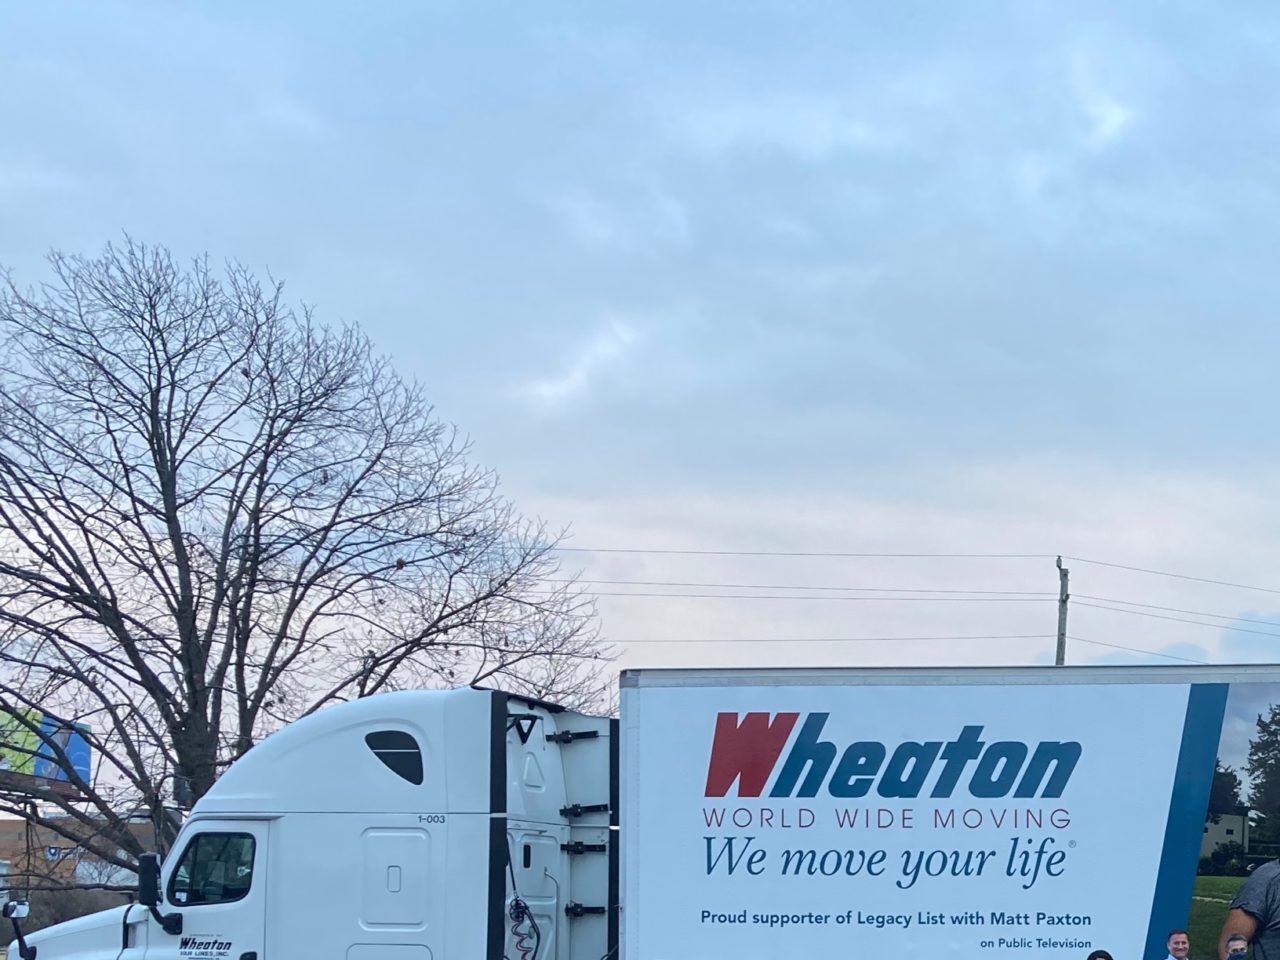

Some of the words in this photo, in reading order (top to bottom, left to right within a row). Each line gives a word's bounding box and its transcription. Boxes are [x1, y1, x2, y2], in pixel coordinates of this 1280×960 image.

[704, 712, 1082, 798] Wheaton
[417, 815, 446, 824] 1-003
[702, 807, 815, 829] WORLD
[834, 808, 913, 829] WIDE
[934, 808, 1071, 829] MOVING
[703, 836, 767, 876] We
[781, 849, 887, 876] move
[896, 849, 996, 889] your
[701, 910, 747, 924] Proud
[752, 912, 831, 928] supporter
[835, 911, 853, 925] of
[857, 911, 912, 928] Legacy
[918, 911, 946, 925] List
[950, 911, 985, 925] with
[990, 912, 1030, 925] Matt
[1036, 912, 1092, 926] Paxton
[179, 937, 232, 950] Wheaton
[980, 941, 995, 949] on
[998, 937, 1033, 949] Public
[1035, 938, 1092, 949] Television
